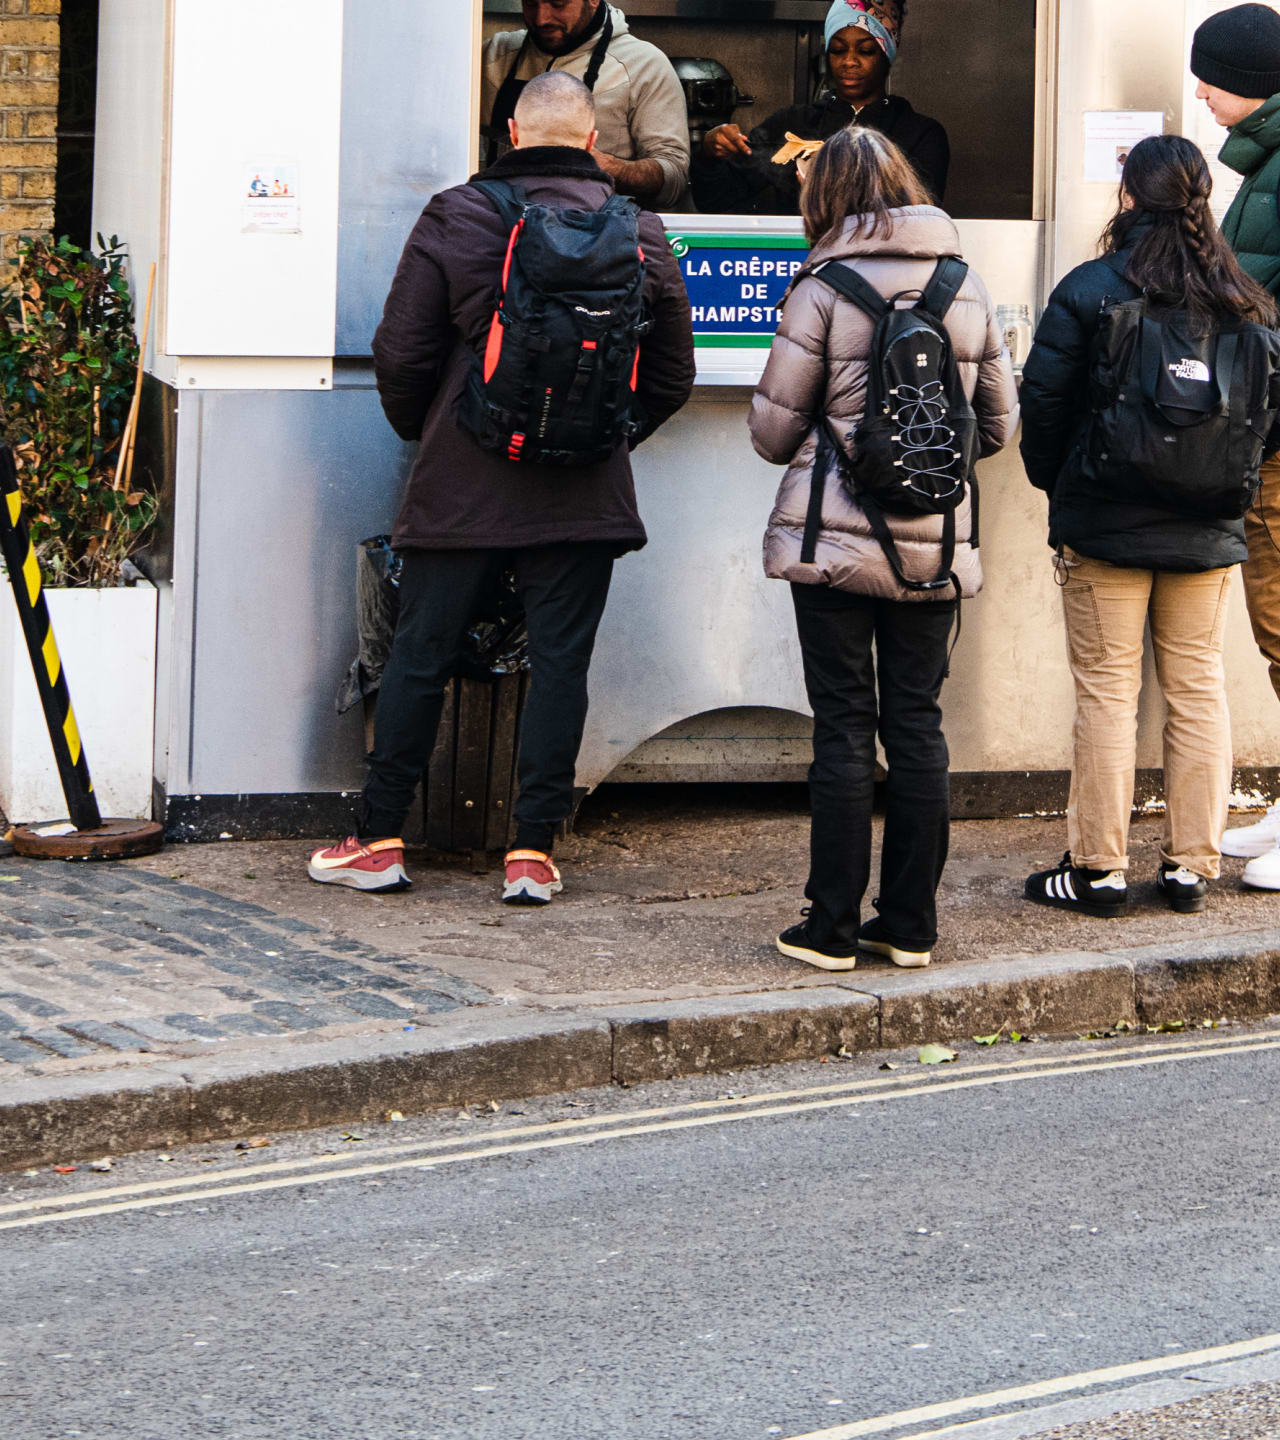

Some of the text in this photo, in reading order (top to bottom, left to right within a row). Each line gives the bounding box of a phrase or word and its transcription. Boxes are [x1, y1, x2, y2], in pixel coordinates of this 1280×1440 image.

[686, 256, 802, 276] LA CRÊPER
[741, 283, 768, 300] DE
[691, 305, 784, 322] HAMPSTE
